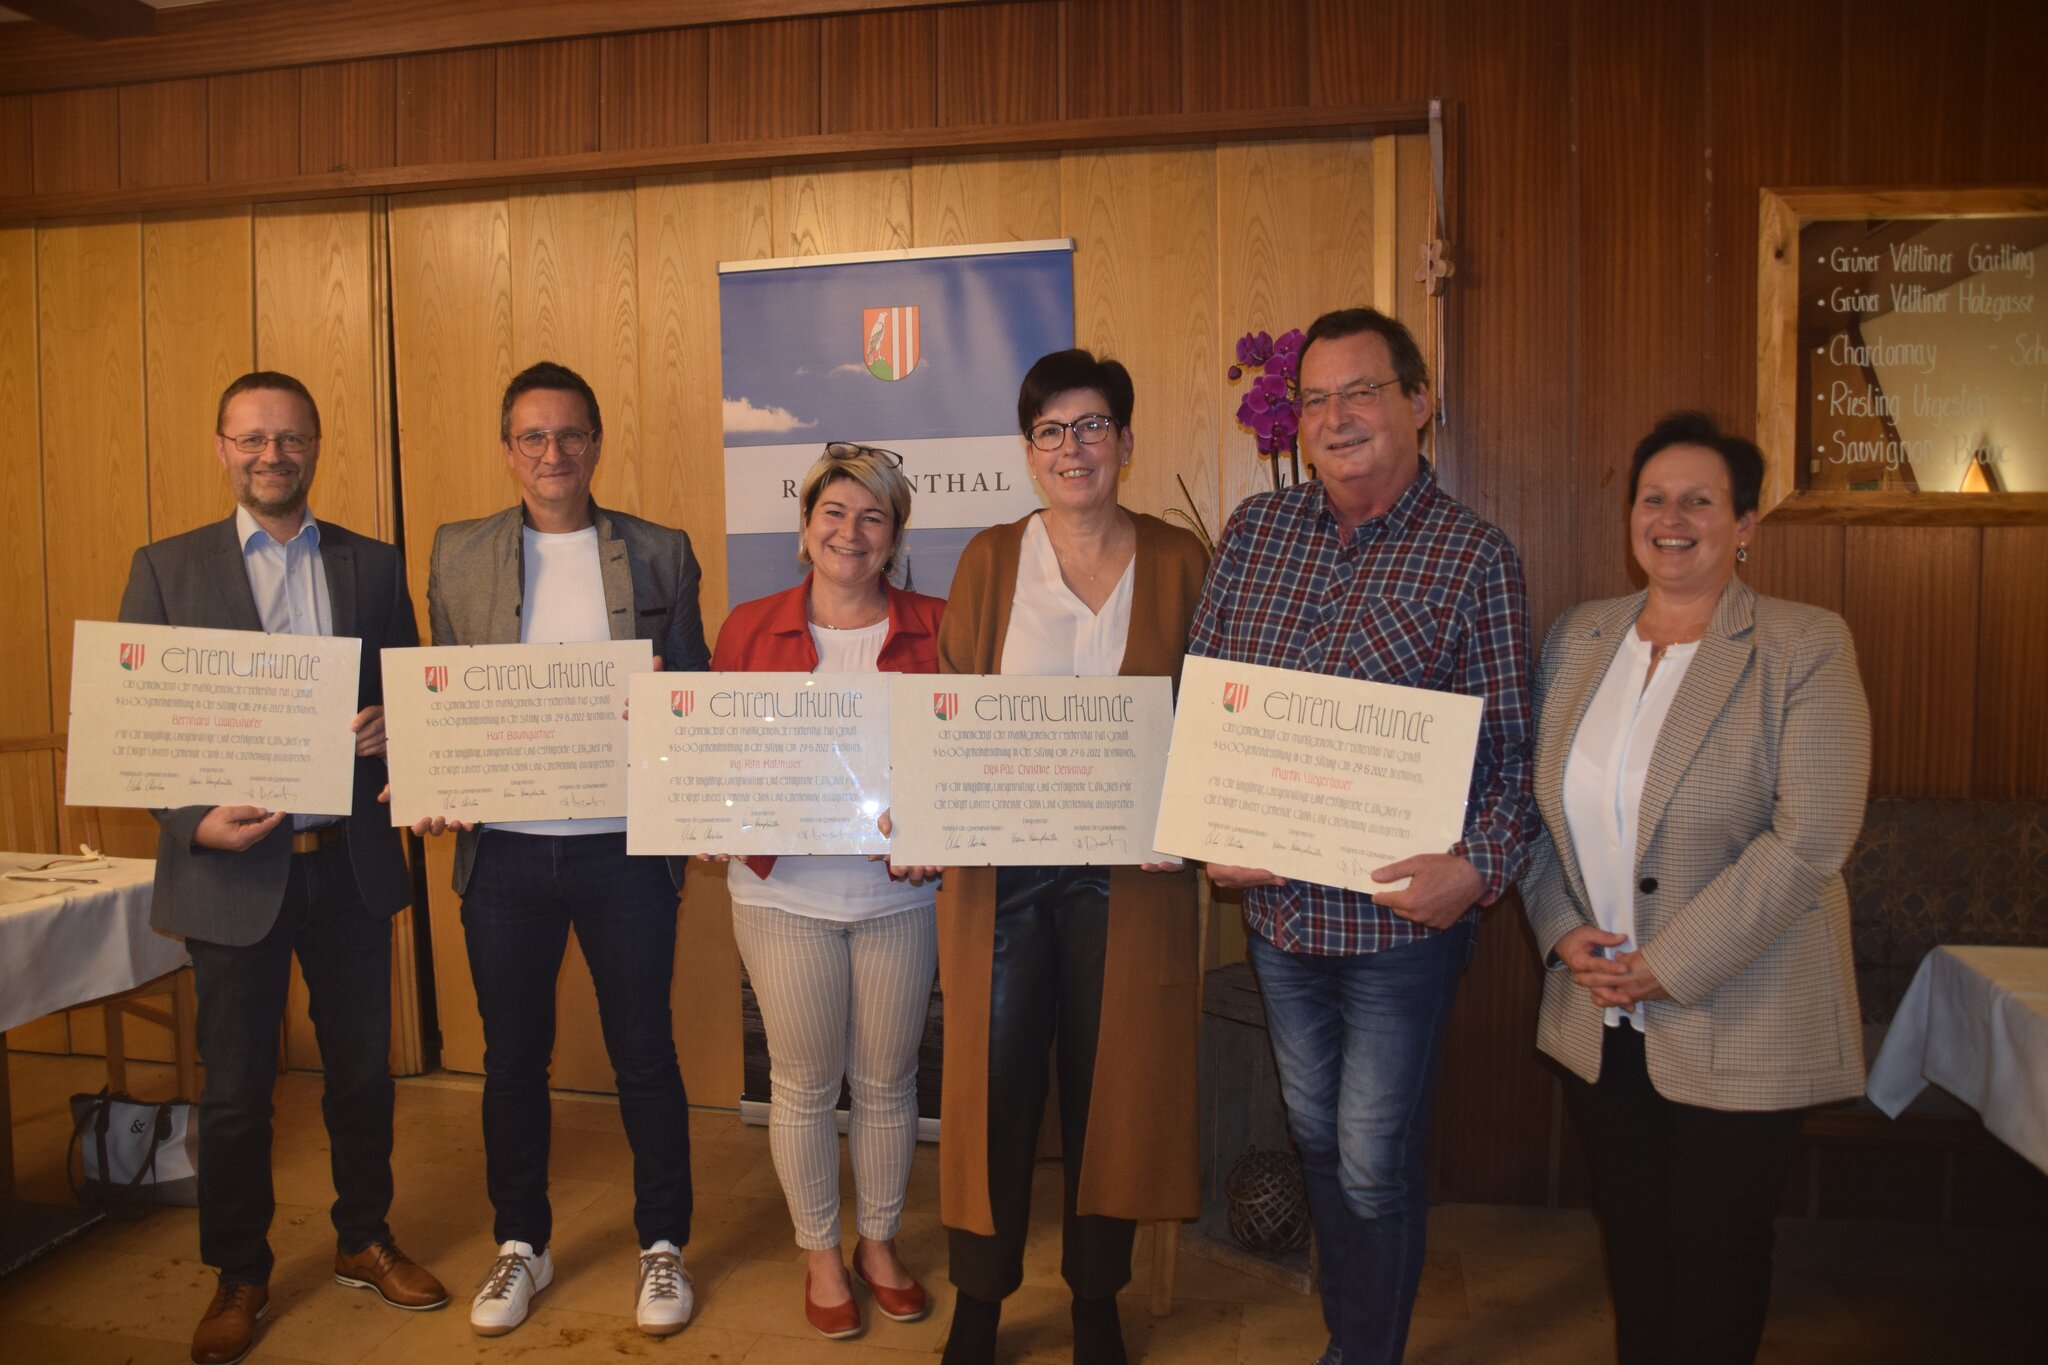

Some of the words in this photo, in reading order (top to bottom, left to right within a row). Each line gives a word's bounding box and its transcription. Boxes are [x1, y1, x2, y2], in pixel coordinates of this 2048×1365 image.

[1889, 242, 1954, 274] Veltliner
[1889, 283, 1949, 313] Veltliner
[1829, 334, 1937, 375] Chardonnay
[2008, 331, 2048, 367] Sch
[1829, 380, 1900, 427] Riesling
[782, 471, 1011, 499] RNTHAL
